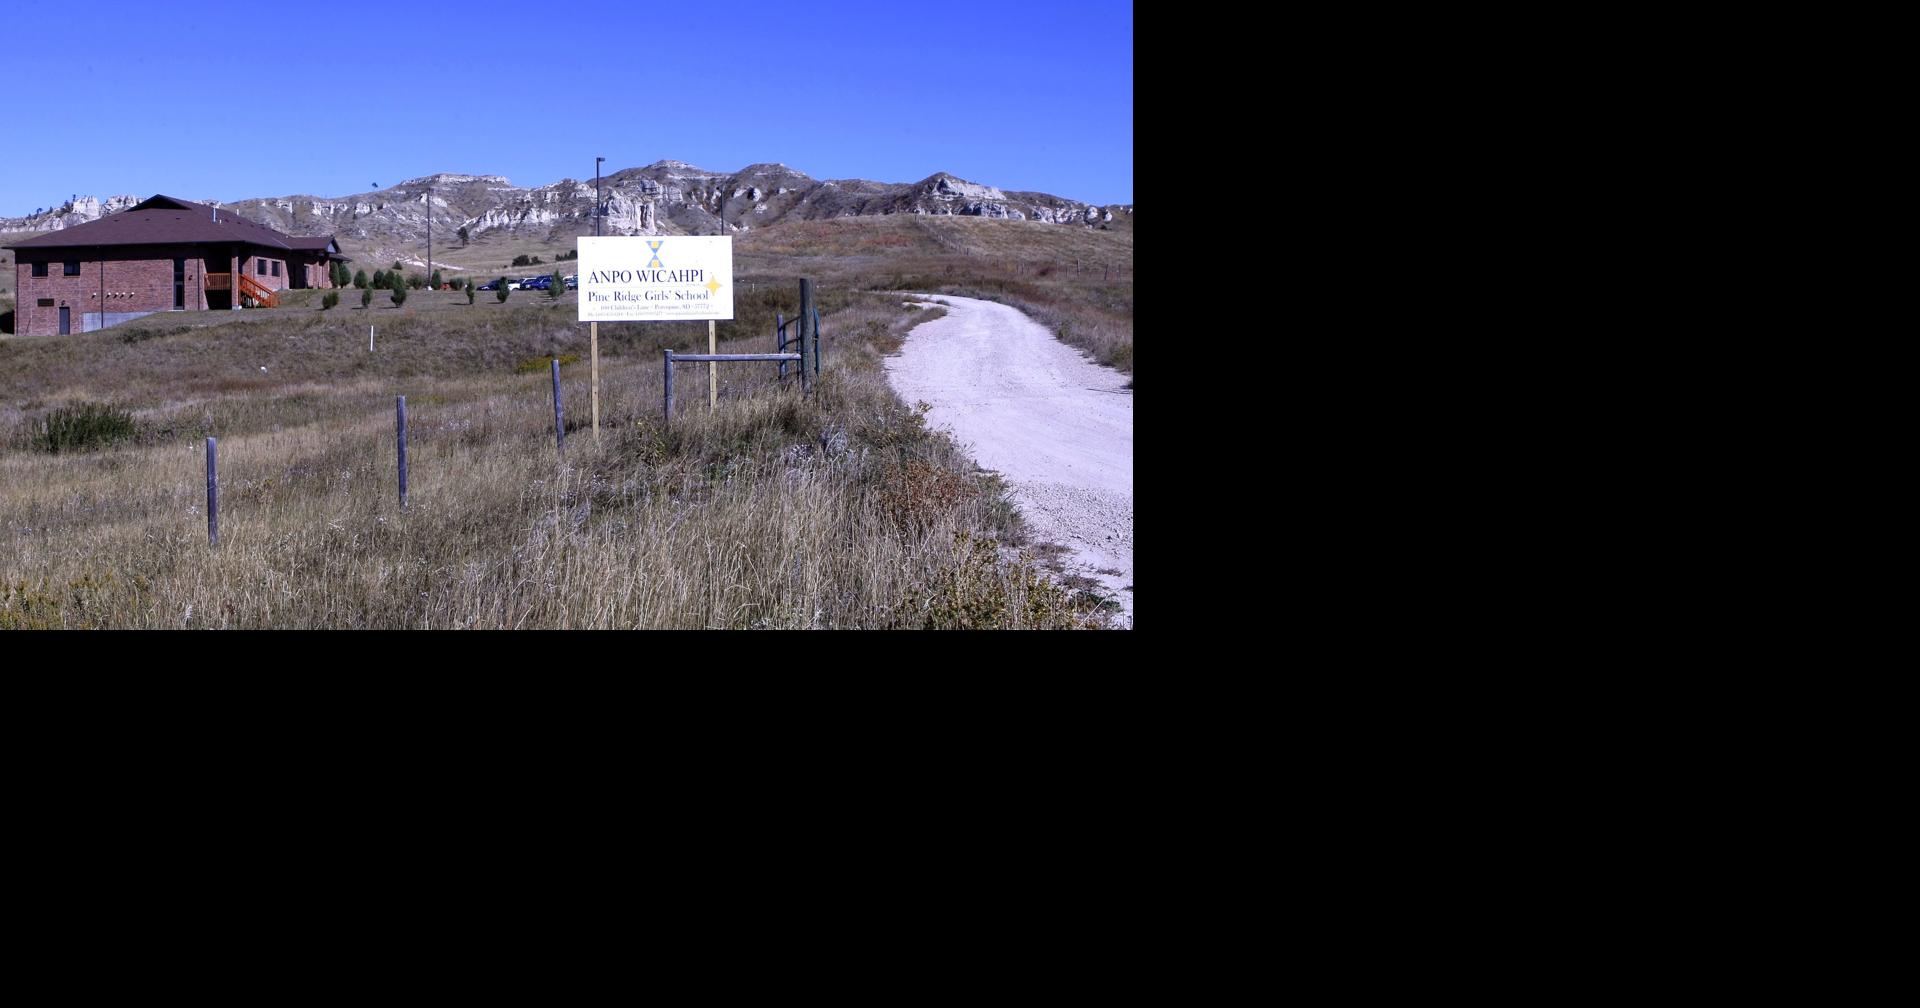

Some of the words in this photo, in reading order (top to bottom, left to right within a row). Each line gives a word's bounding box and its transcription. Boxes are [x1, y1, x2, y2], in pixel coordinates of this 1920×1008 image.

[588, 270, 632, 284] ANPO
[636, 269, 703, 283] WICAHPI
[588, 291, 610, 302] Pine
[614, 291, 641, 303] Ridge
[645, 290, 672, 301] Girls'
[675, 290, 709, 301] School
